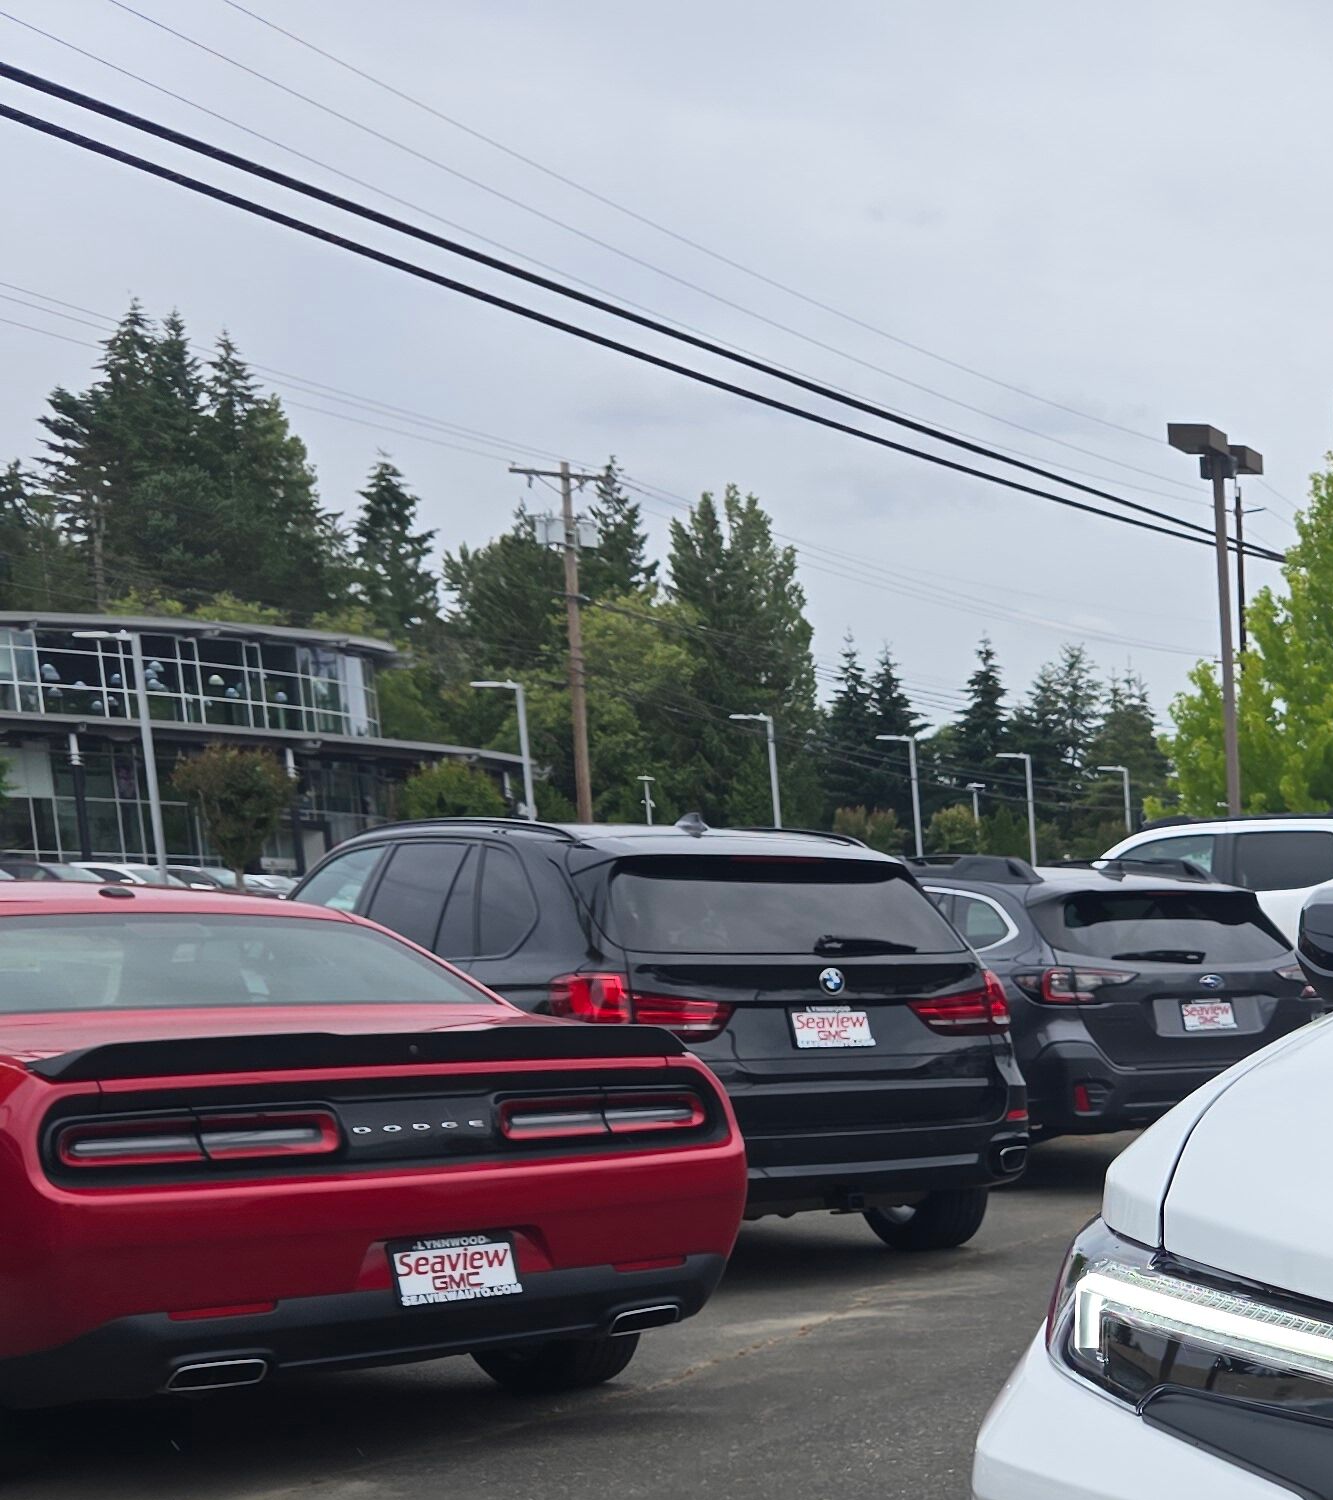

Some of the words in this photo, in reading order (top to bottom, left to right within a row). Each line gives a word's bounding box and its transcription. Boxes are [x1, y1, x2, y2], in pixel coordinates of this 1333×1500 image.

[795, 1012, 866, 1029] Seaview
[352, 1119, 485, 1134] DODGE
[416, 1235, 487, 1250] LYNNWOOD
[397, 1247, 509, 1277] Seaview
[432, 1272, 484, 1291] GMC
